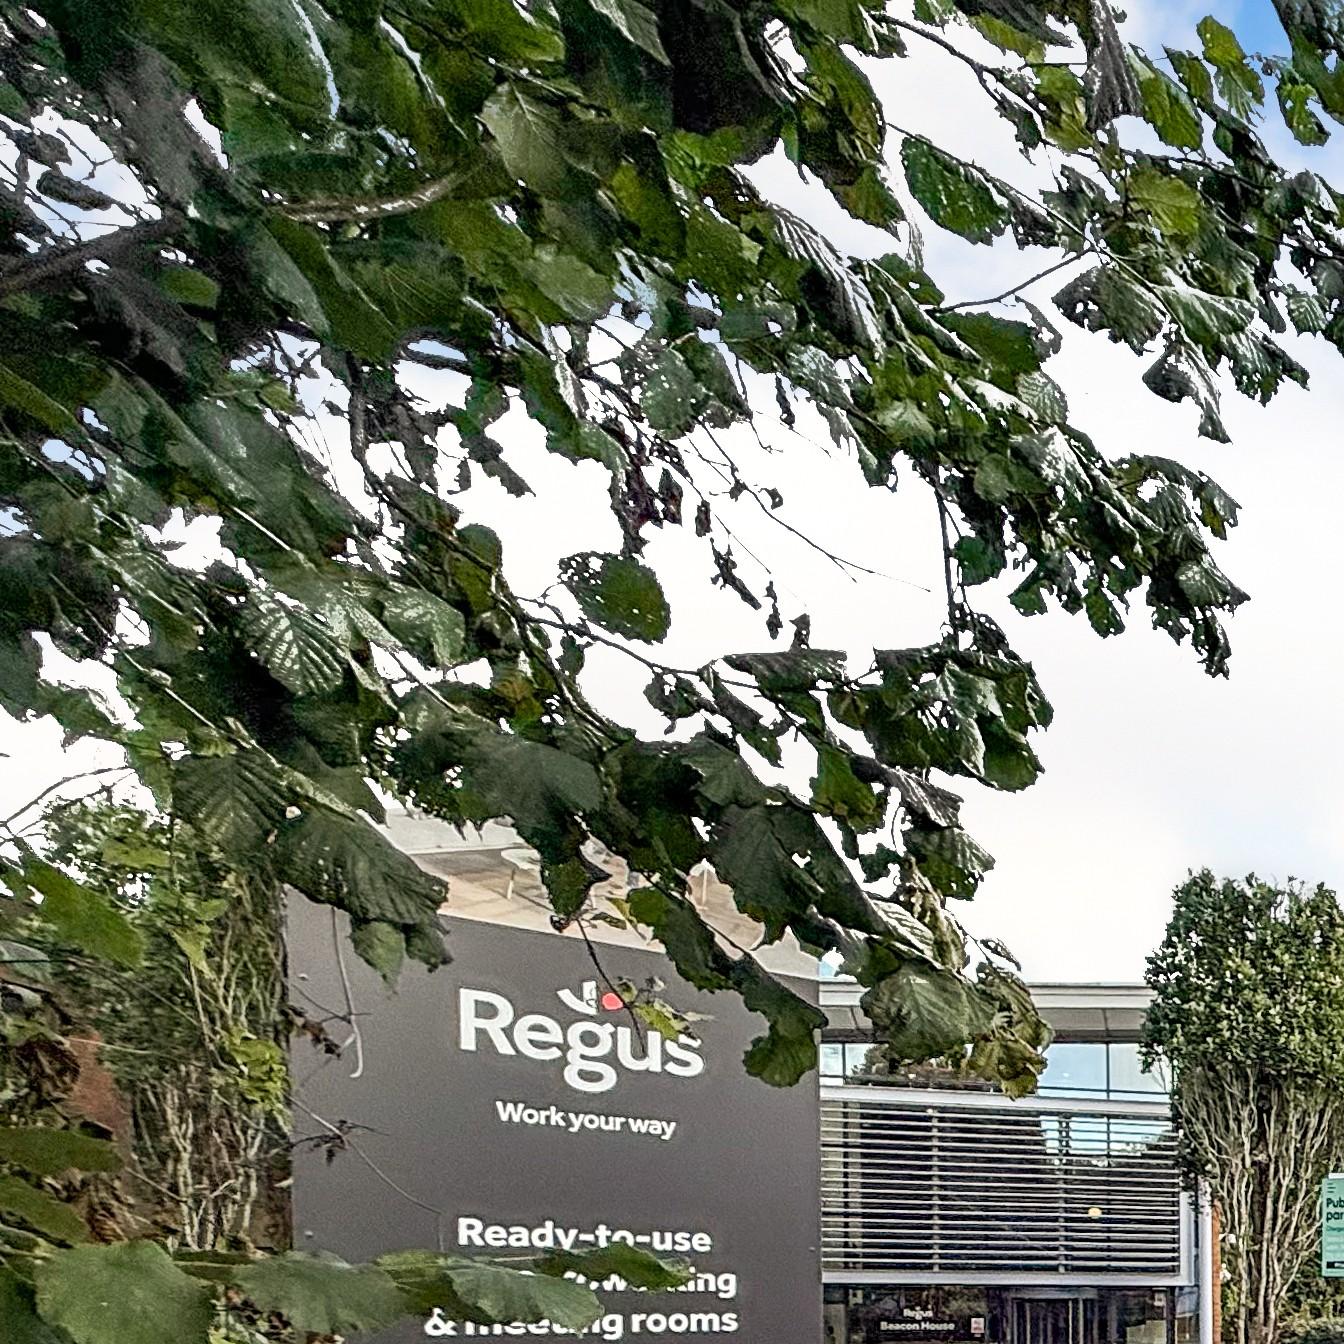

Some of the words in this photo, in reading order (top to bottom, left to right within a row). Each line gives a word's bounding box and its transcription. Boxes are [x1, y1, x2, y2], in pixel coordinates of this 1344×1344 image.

[460, 987, 705, 1093] Regus
[495, 1101, 566, 1127] Work
[567, 1109, 626, 1133] your
[628, 1117, 677, 1141] way
[457, 1216, 713, 1252] Ready-to-use
[424, 1308, 458, 1337] &
[631, 1311, 739, 1334] rooms
[880, 1321, 920, 1331] Beacon
[920, 1321, 956, 1331] House
